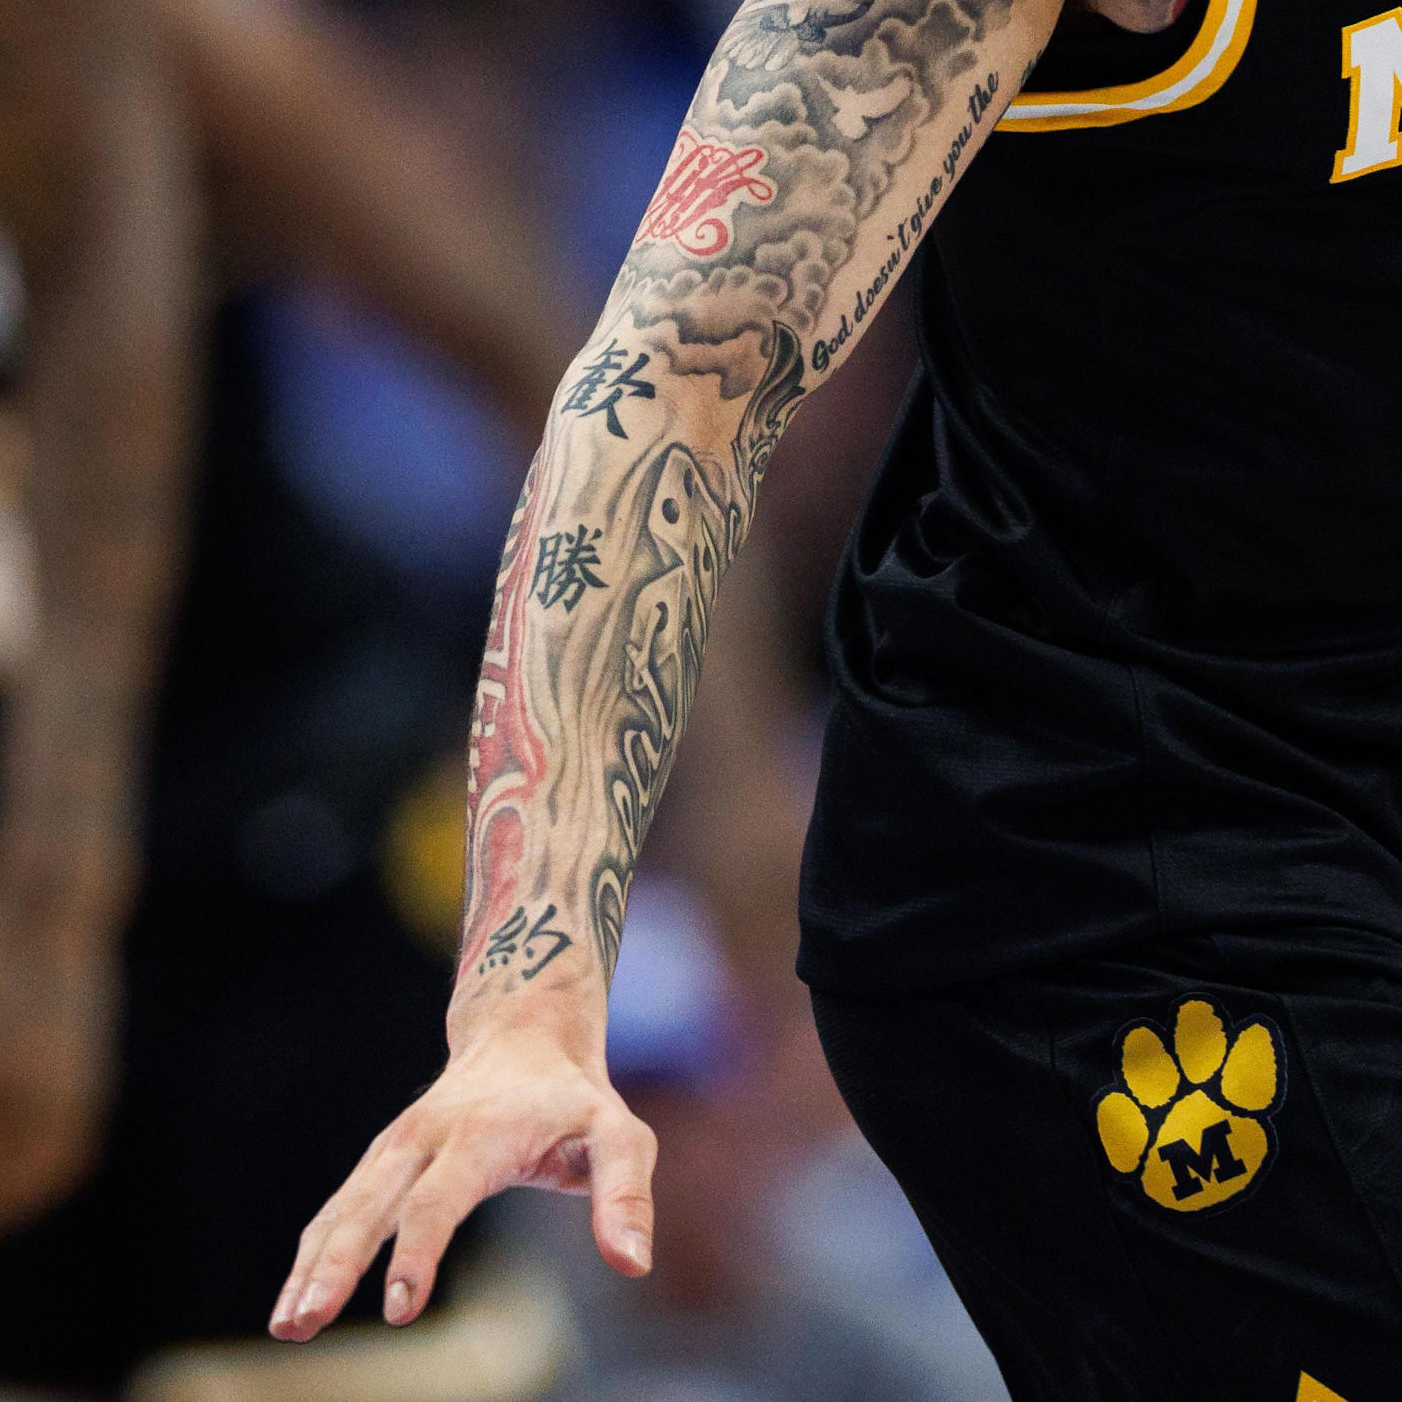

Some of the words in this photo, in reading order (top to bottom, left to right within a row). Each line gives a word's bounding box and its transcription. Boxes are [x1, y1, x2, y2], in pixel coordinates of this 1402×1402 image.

[811, 314, 854, 374] God
[909, 175, 943, 241] give
[943, 122, 973, 183] you
[967, 70, 999, 125] the
[1156, 1119, 1247, 1203] M
